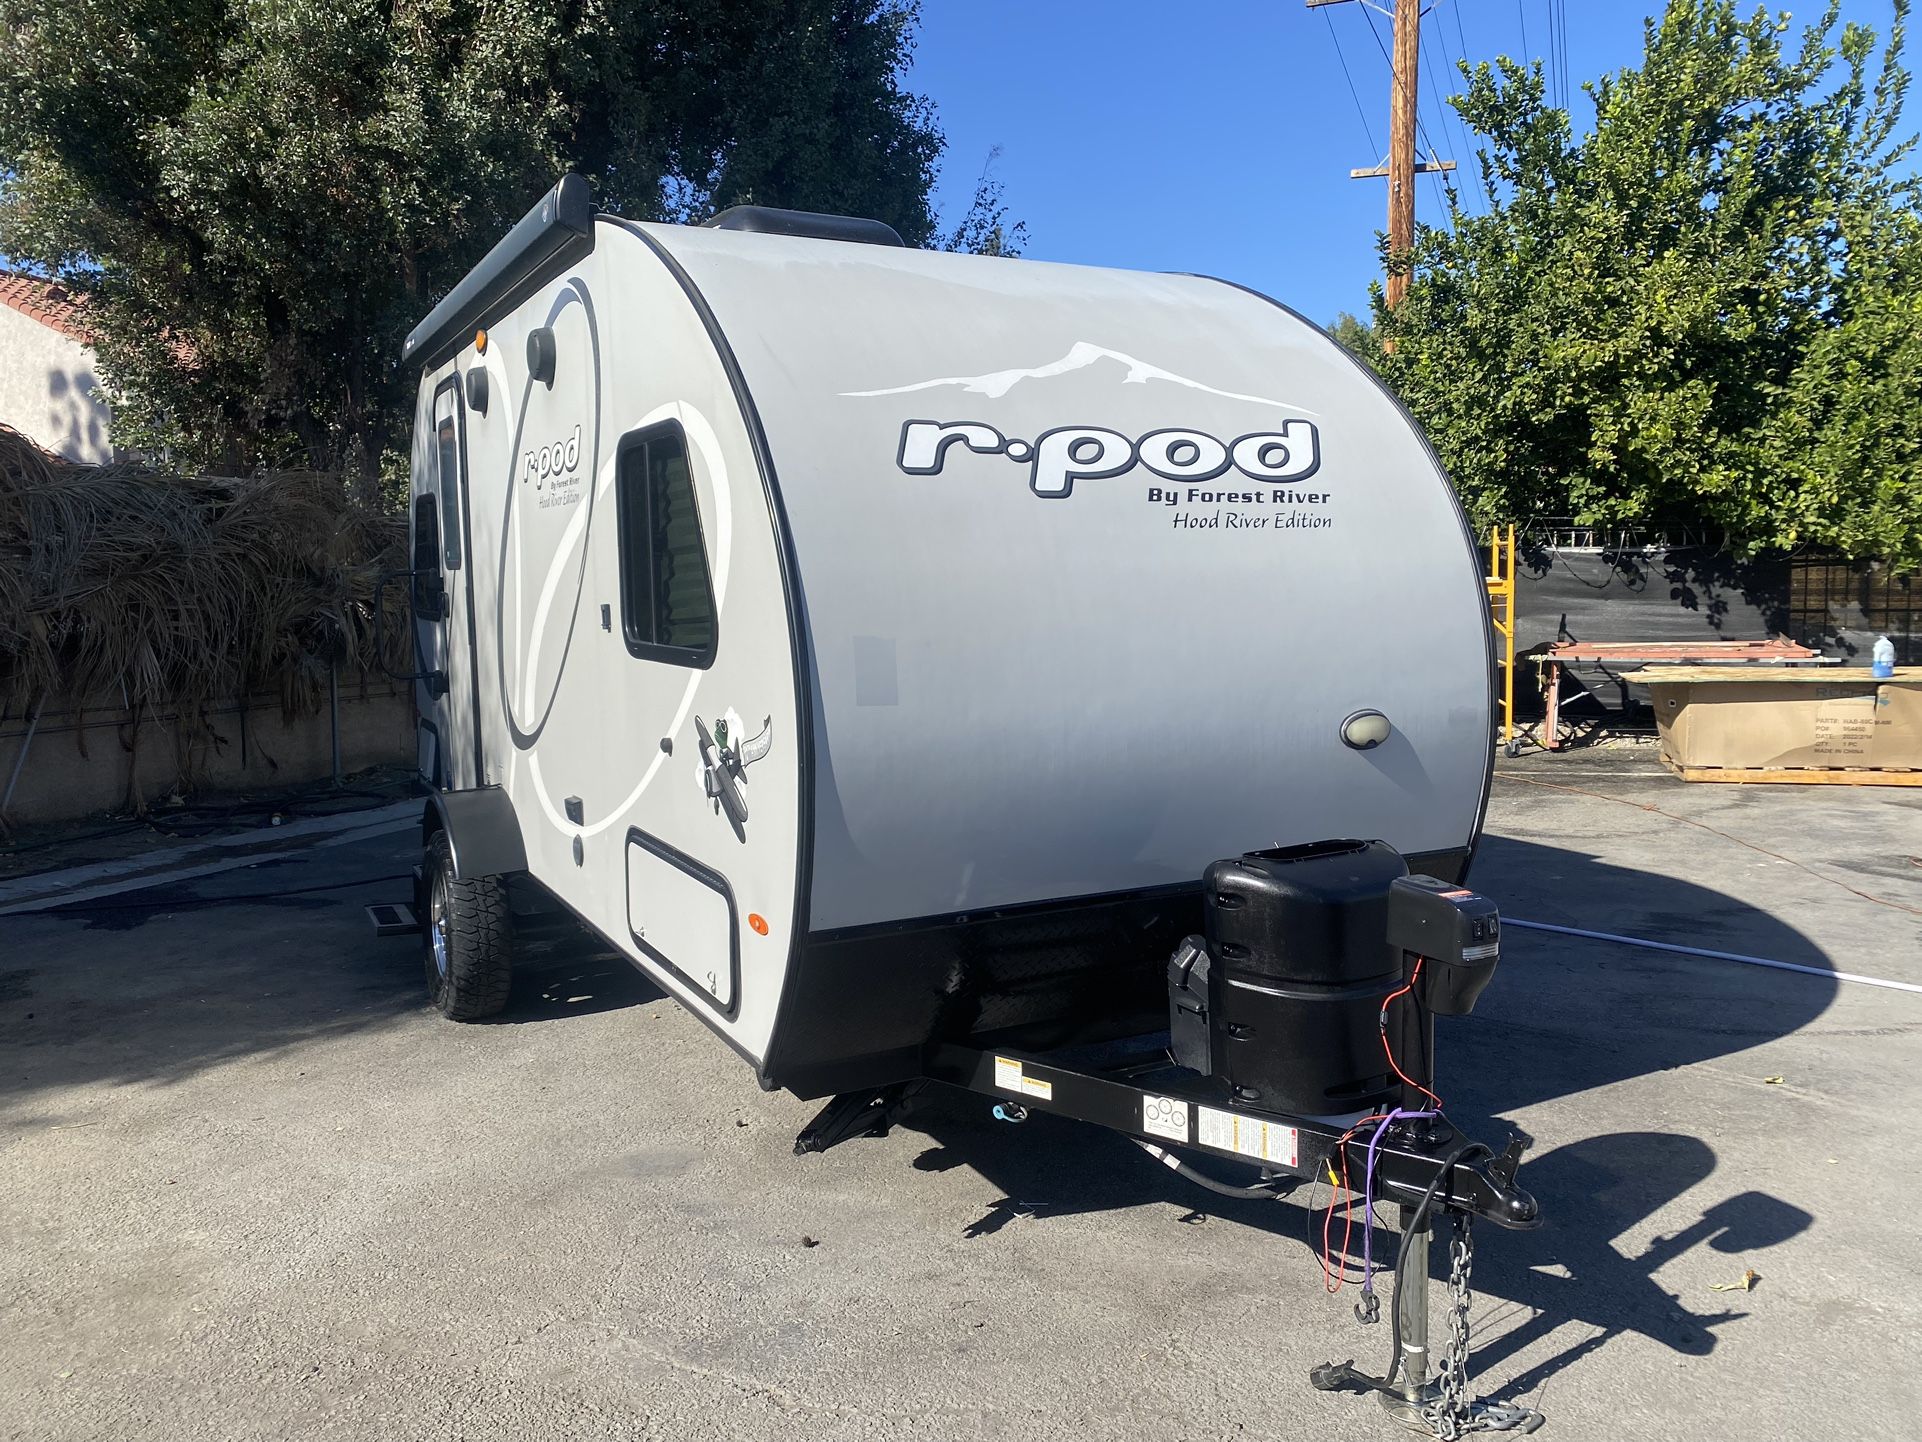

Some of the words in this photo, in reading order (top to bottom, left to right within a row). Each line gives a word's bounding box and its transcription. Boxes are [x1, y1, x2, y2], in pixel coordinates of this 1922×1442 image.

[1148, 488, 1178, 506] By
[1187, 488, 1265, 503] Forest
[1272, 489, 1331, 504] River
[1173, 510, 1220, 529] Hood
[1225, 512, 1269, 529] River
[1274, 510, 1332, 529] Edition
